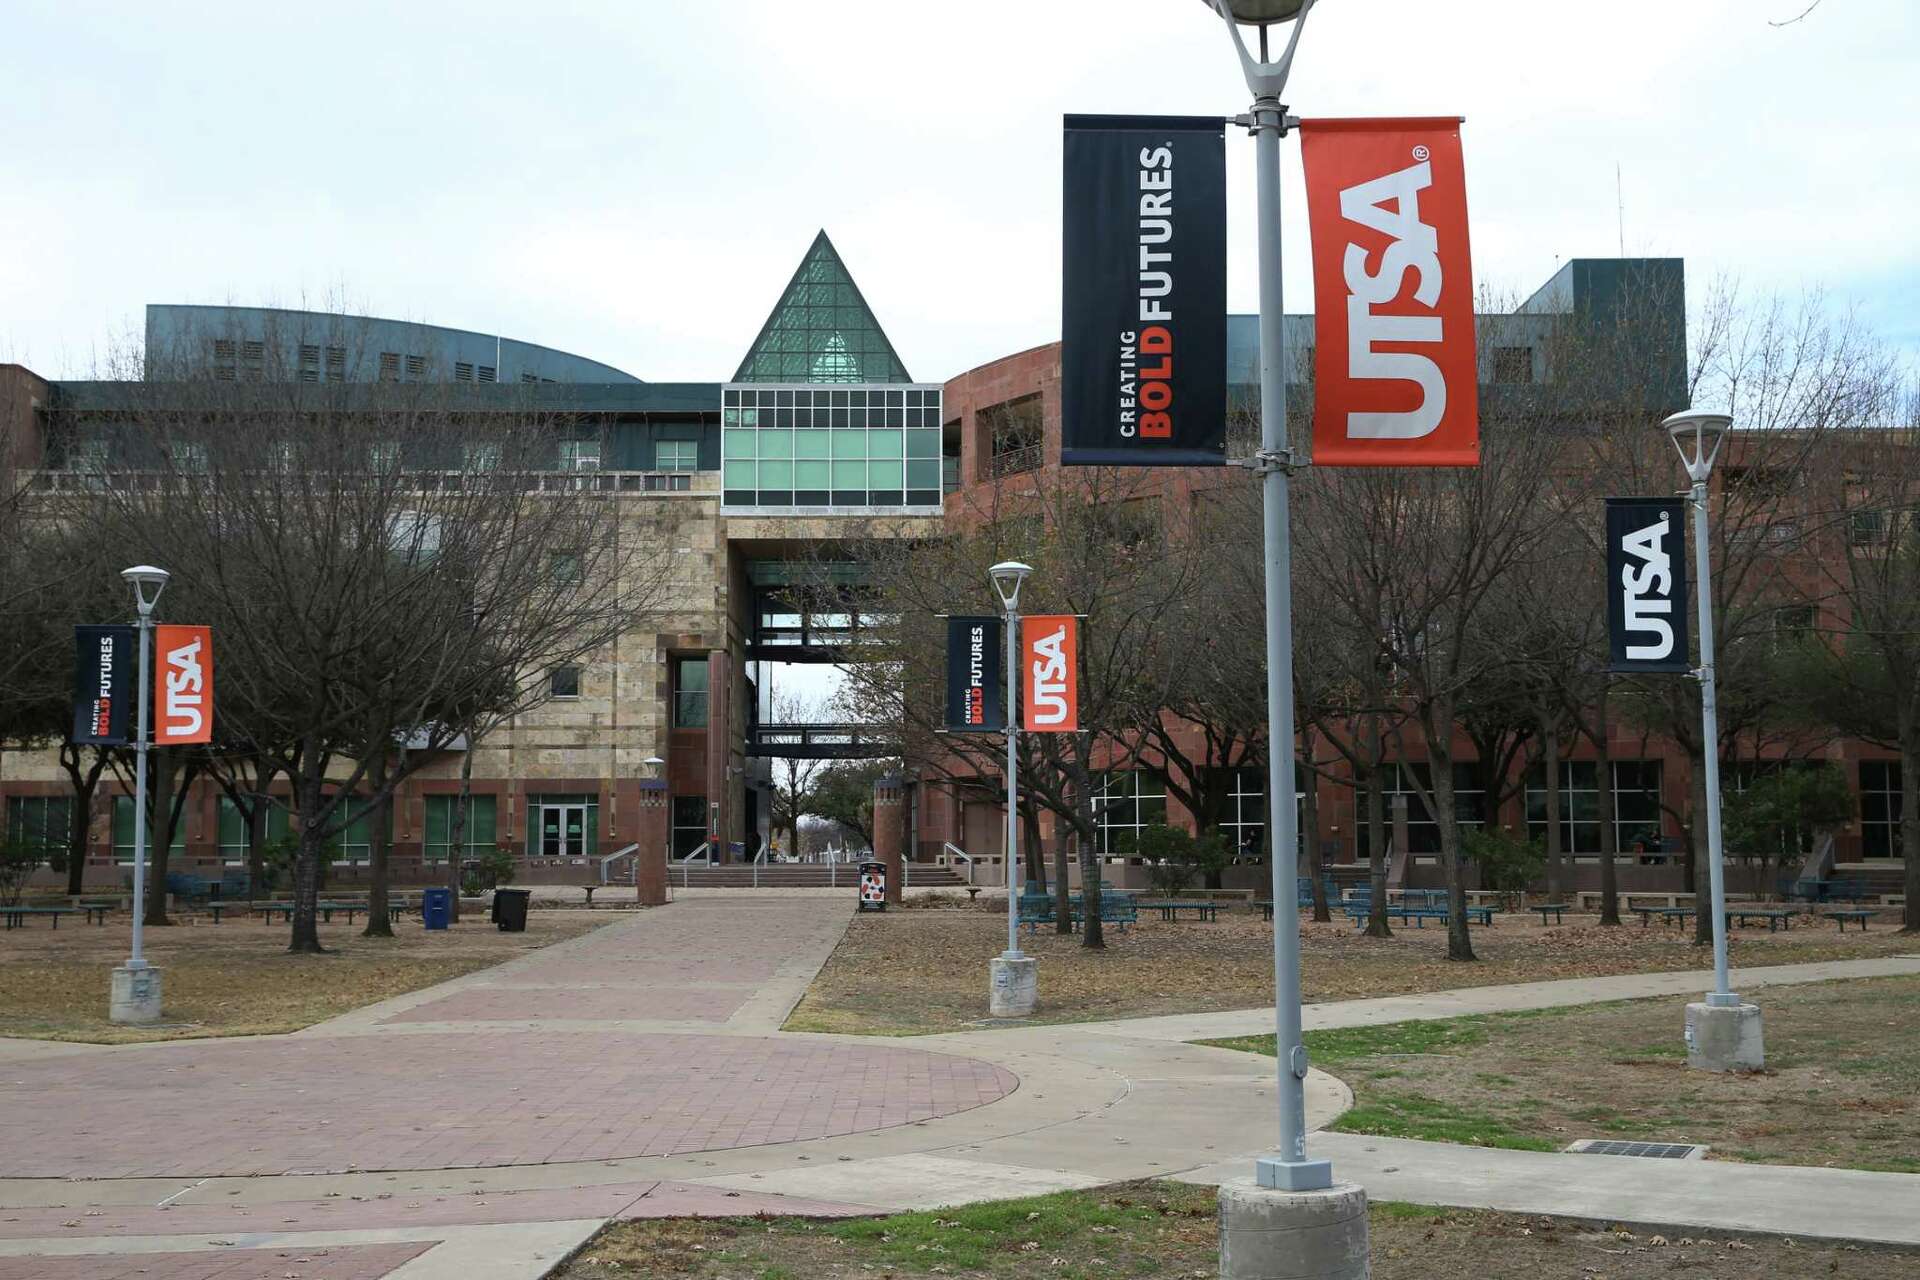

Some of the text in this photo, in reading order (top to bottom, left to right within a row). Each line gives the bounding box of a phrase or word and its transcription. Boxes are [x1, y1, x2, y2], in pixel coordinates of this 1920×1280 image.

[1339, 161, 1447, 439] UTSA
[1120, 330, 1136, 438] CREATING
[1139, 326, 1172, 438] BOLD
[1622, 519, 1675, 660] UTSA
[91, 699, 100, 735] CREATING
[98, 699, 111, 736] BOLD
[167, 641, 202, 735] UTSA
[972, 688, 983, 724] BOLD
[1033, 631, 1067, 724] UTSA
